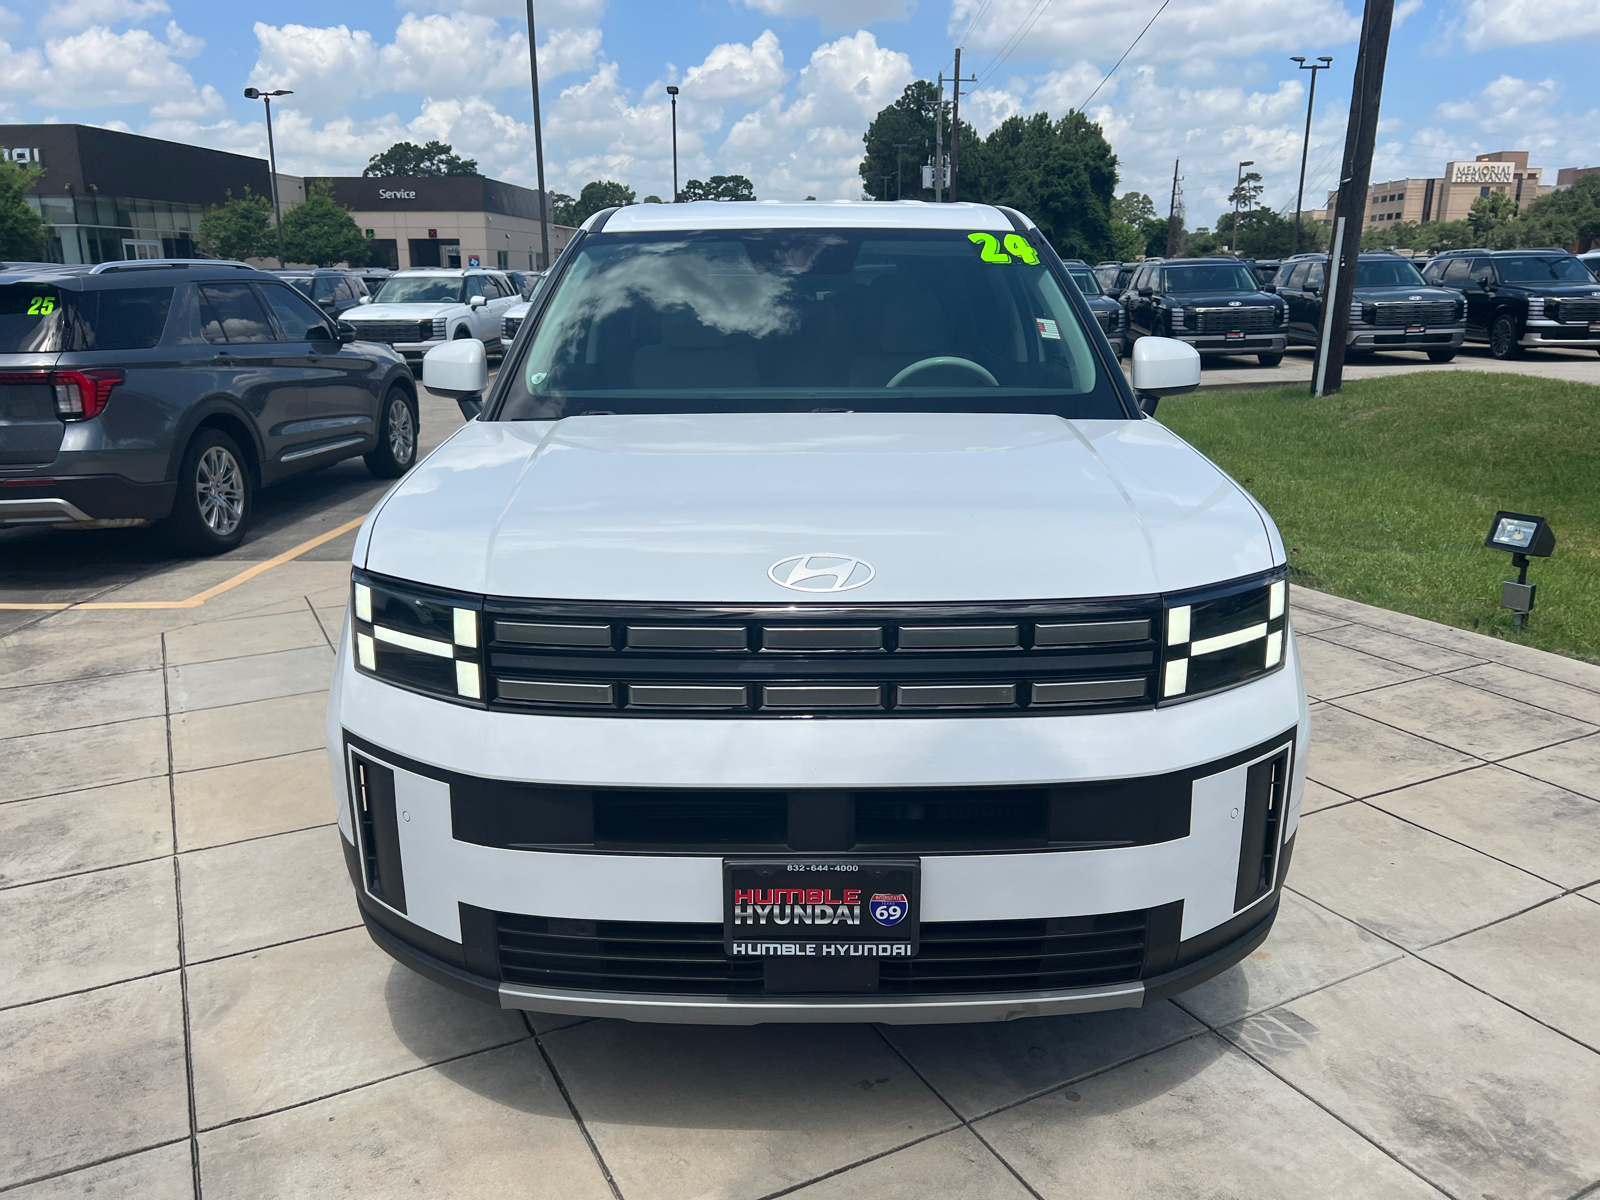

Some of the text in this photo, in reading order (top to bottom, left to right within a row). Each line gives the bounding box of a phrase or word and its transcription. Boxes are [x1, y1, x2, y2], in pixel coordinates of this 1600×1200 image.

[1456, 165, 1512, 175] MEMORIAL
[1455, 173, 1509, 182] HERMANN
[379, 188, 416, 199] Service
[967, 232, 1041, 266] 24
[27, 296, 55, 315] 25
[786, 864, 859, 872] 832-644-4000
[734, 888, 862, 905] HUMBLE
[734, 904, 861, 925] HYUNDAI
[875, 905, 902, 920] 69
[733, 943, 912, 957] HUMBLE HYUNDAI
